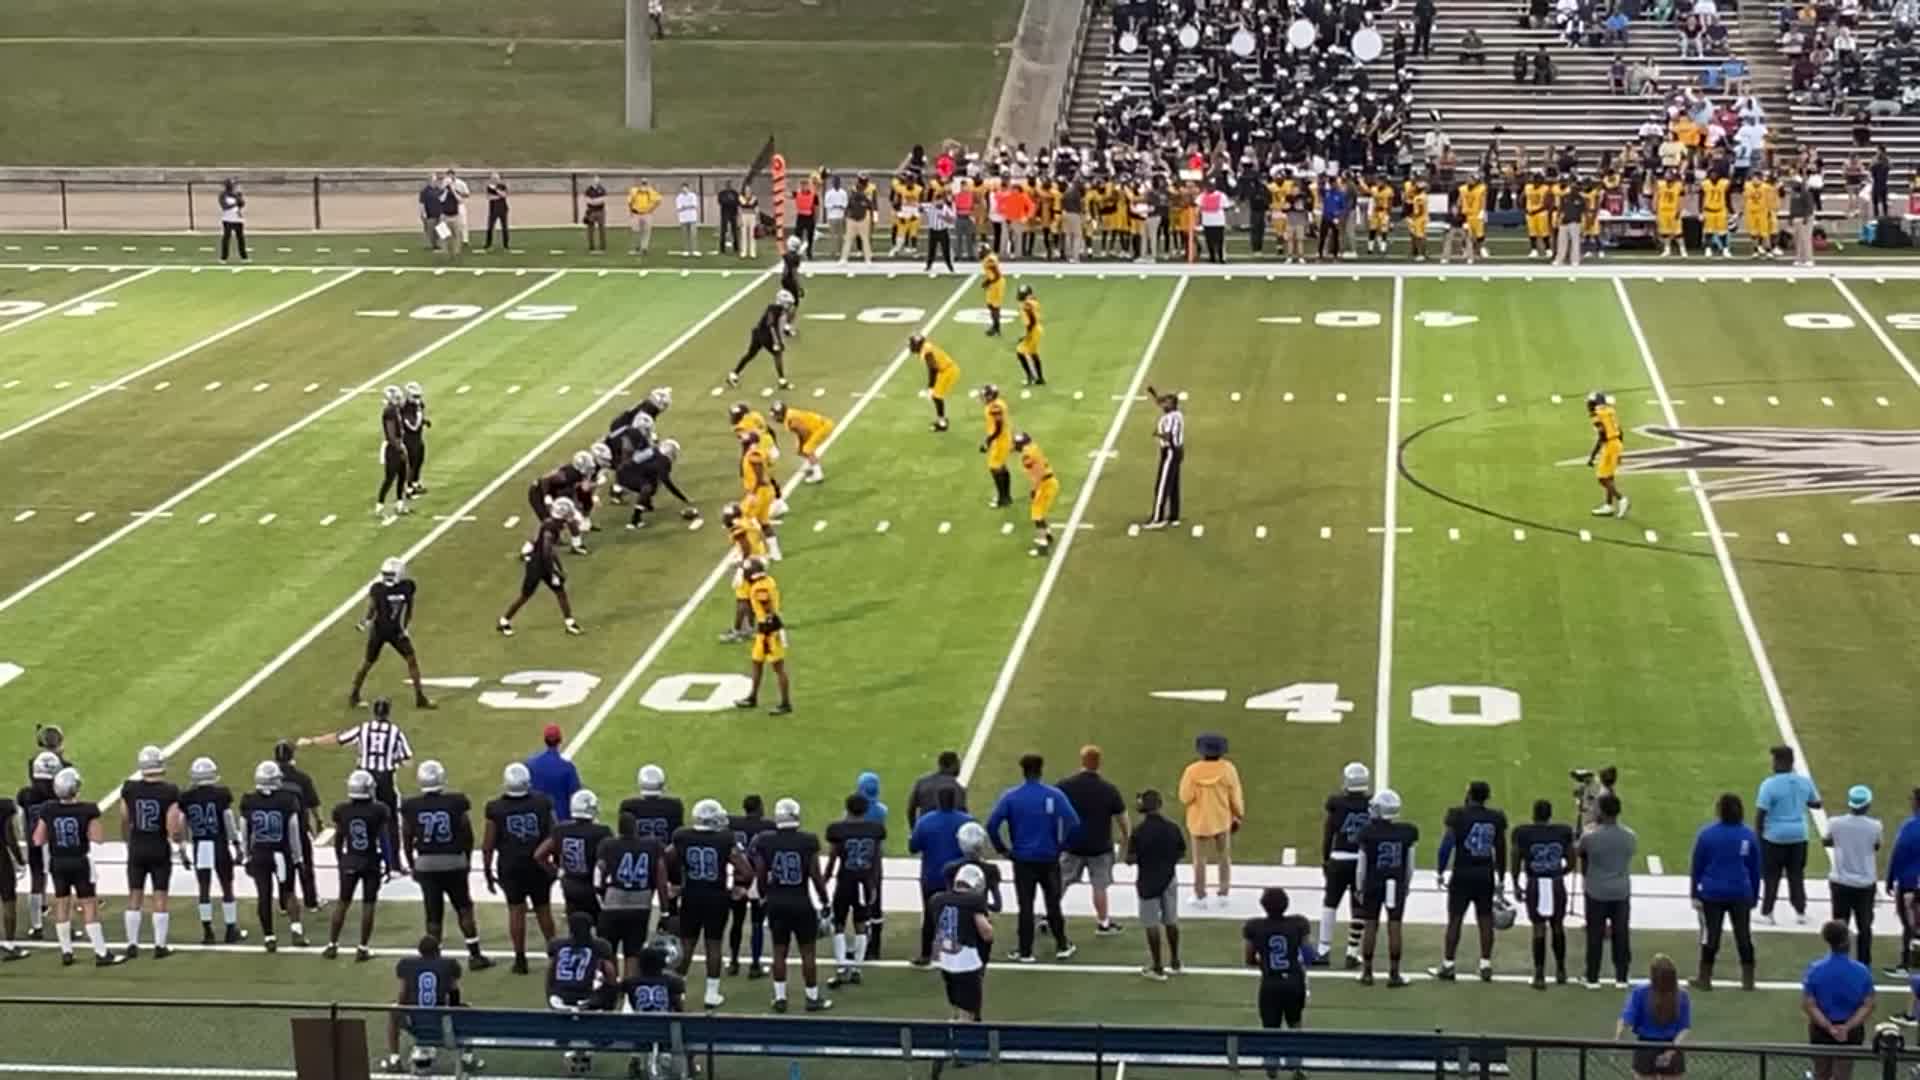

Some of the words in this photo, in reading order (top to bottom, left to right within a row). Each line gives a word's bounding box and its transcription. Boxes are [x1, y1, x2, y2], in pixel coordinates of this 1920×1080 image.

[418, 811, 452, 842] 73
[616, 852, 649, 889] 44
[556, 946, 592, 980] 27
[1268, 935, 1290, 970] 2
[418, 971, 437, 1008] 8
